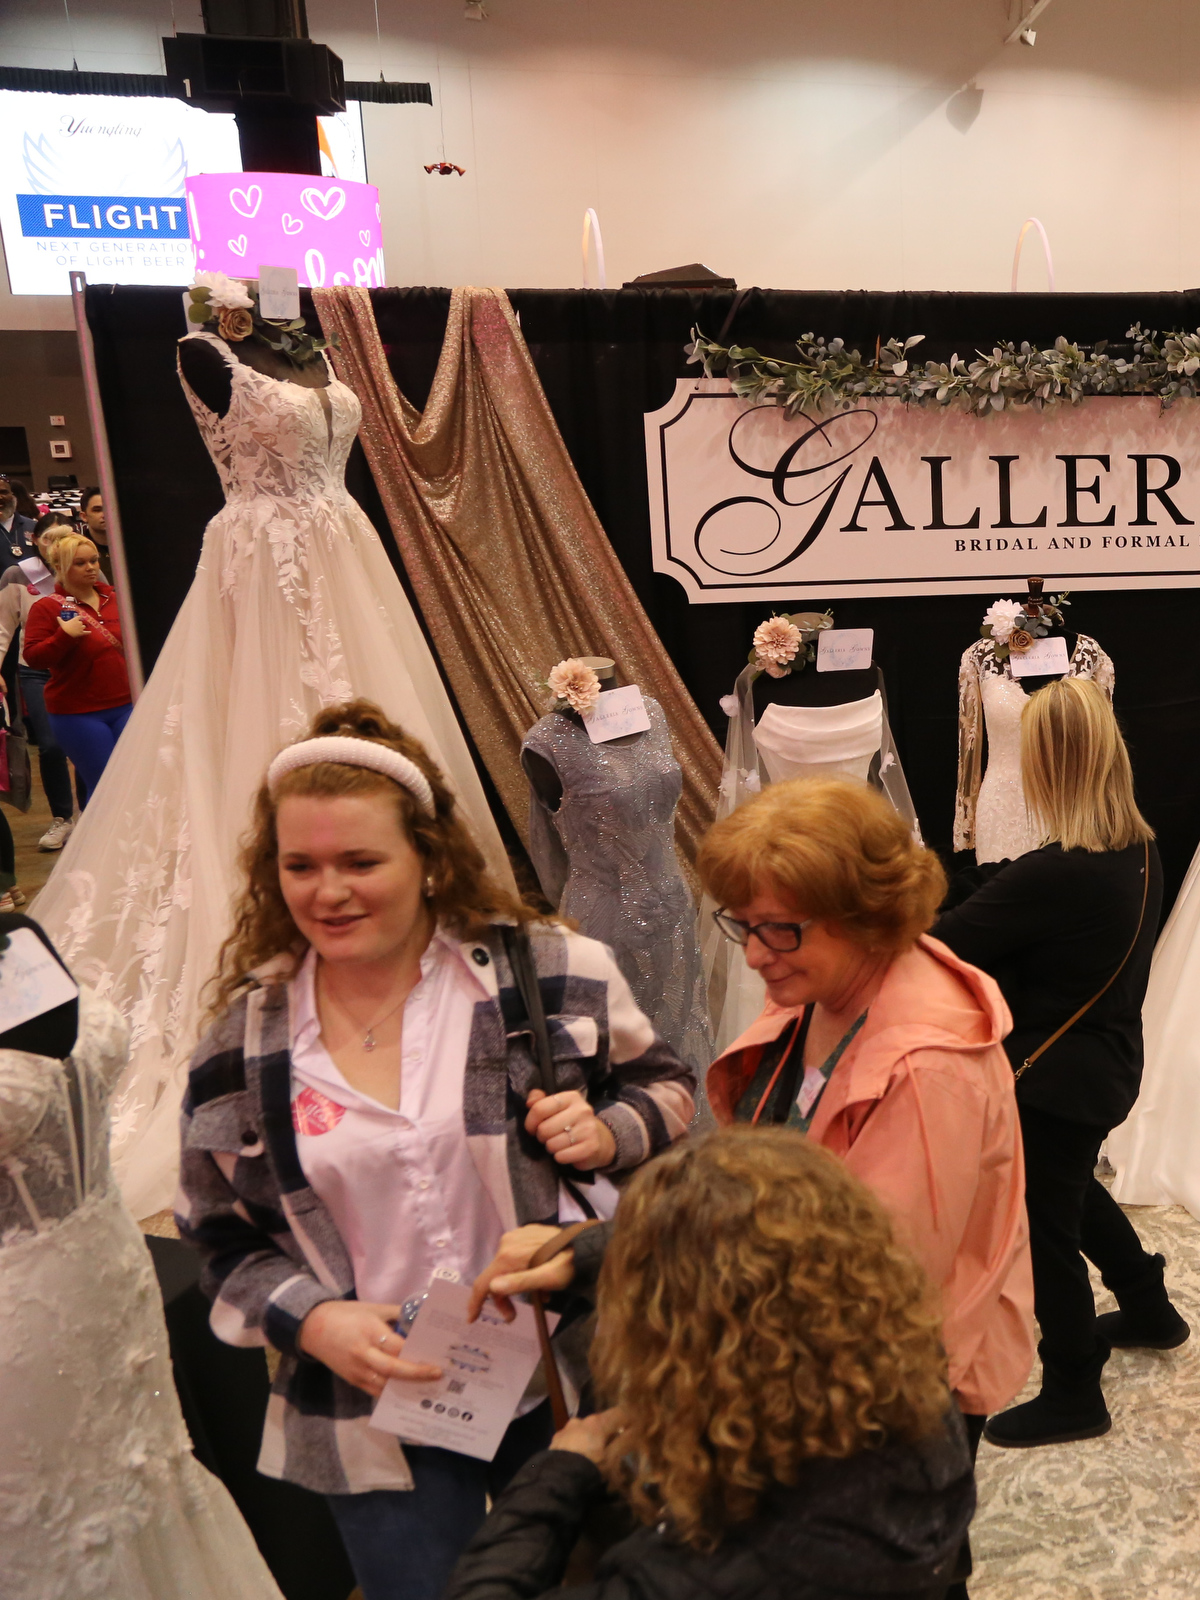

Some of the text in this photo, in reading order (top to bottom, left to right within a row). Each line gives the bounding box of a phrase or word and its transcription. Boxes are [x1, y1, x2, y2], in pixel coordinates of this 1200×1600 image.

[43, 203, 182, 231] FLIGHT
[36, 241, 188, 253] NEXT GENERATIO
[56, 255, 185, 266] OF LIGHT BEER
[954, 537, 1038, 552] BRIDAL
[1047, 536, 1092, 550] AND
[1101, 534, 1190, 549] FORMAL
